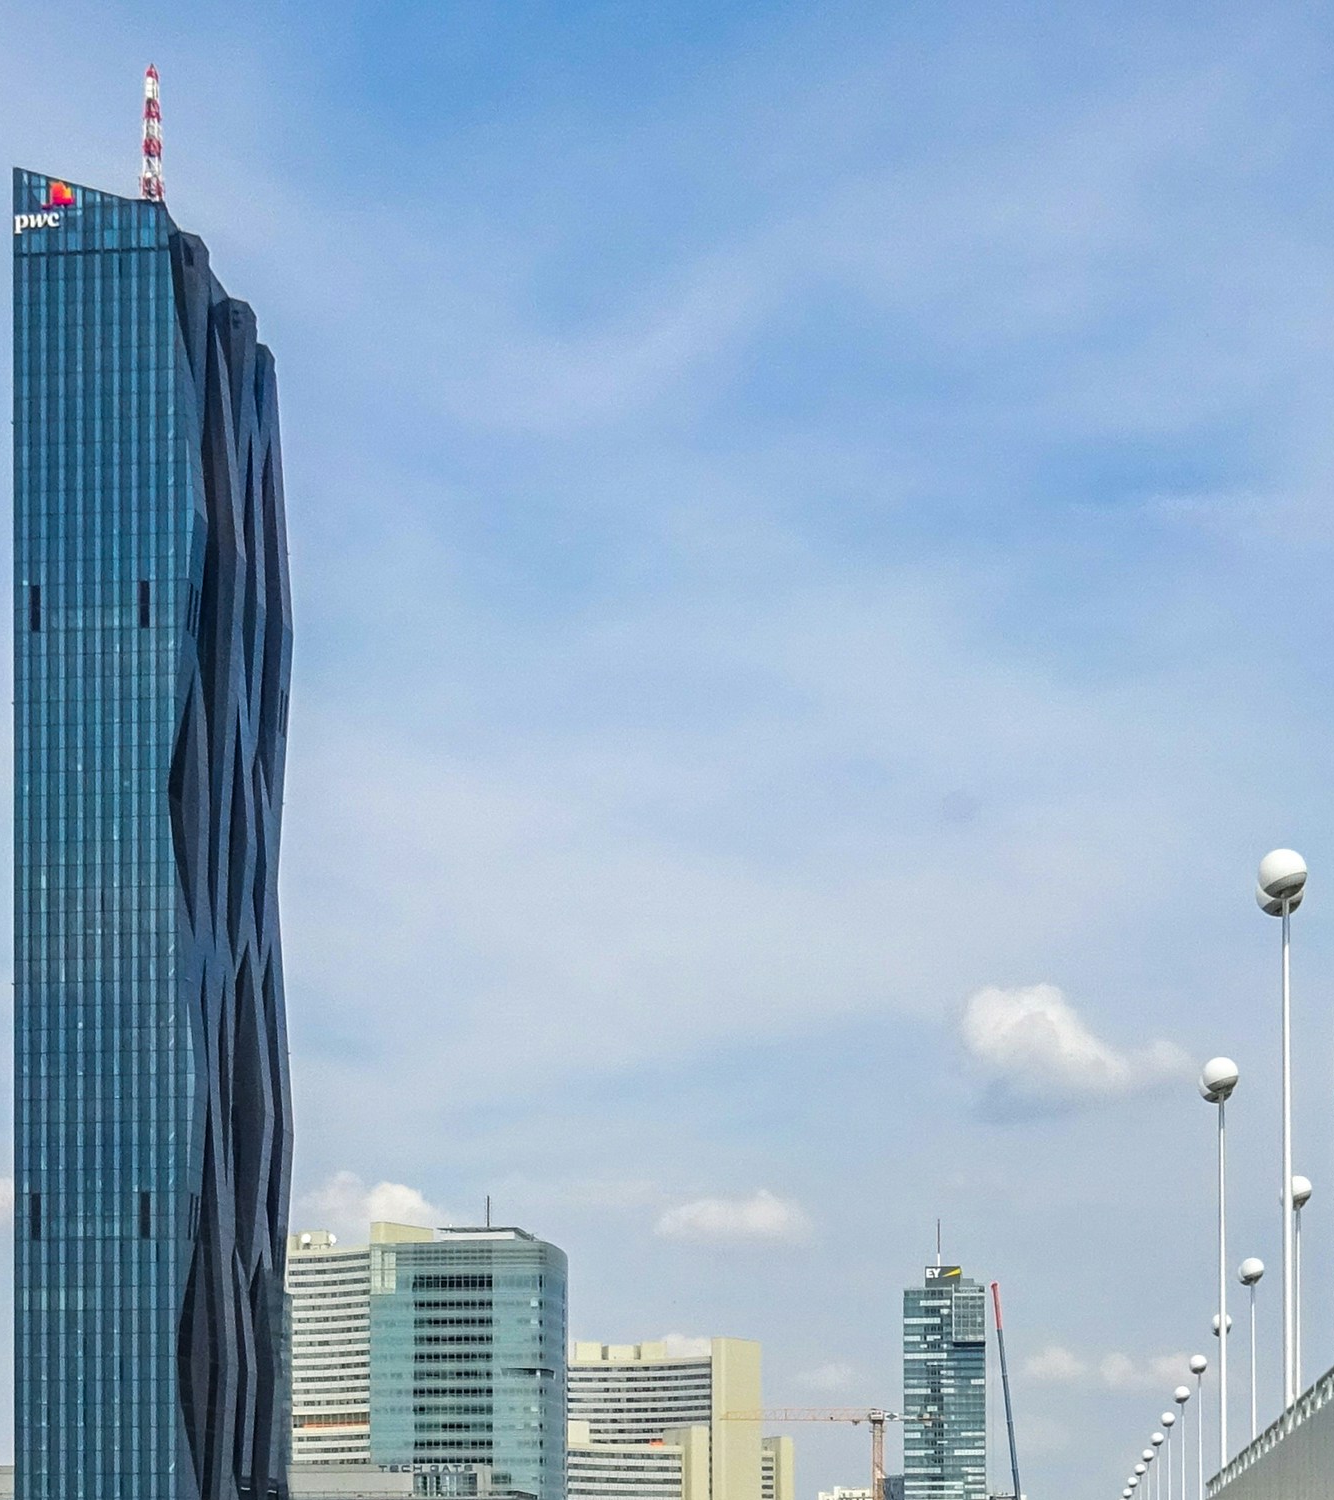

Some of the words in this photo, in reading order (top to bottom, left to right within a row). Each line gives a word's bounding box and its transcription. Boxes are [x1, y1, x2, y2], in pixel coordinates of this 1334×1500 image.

[14, 211, 60, 234] pwc
[926, 1268, 941, 1278] EY
[378, 1464, 423, 1473] TECH
[430, 1464, 473, 1473] GATE
